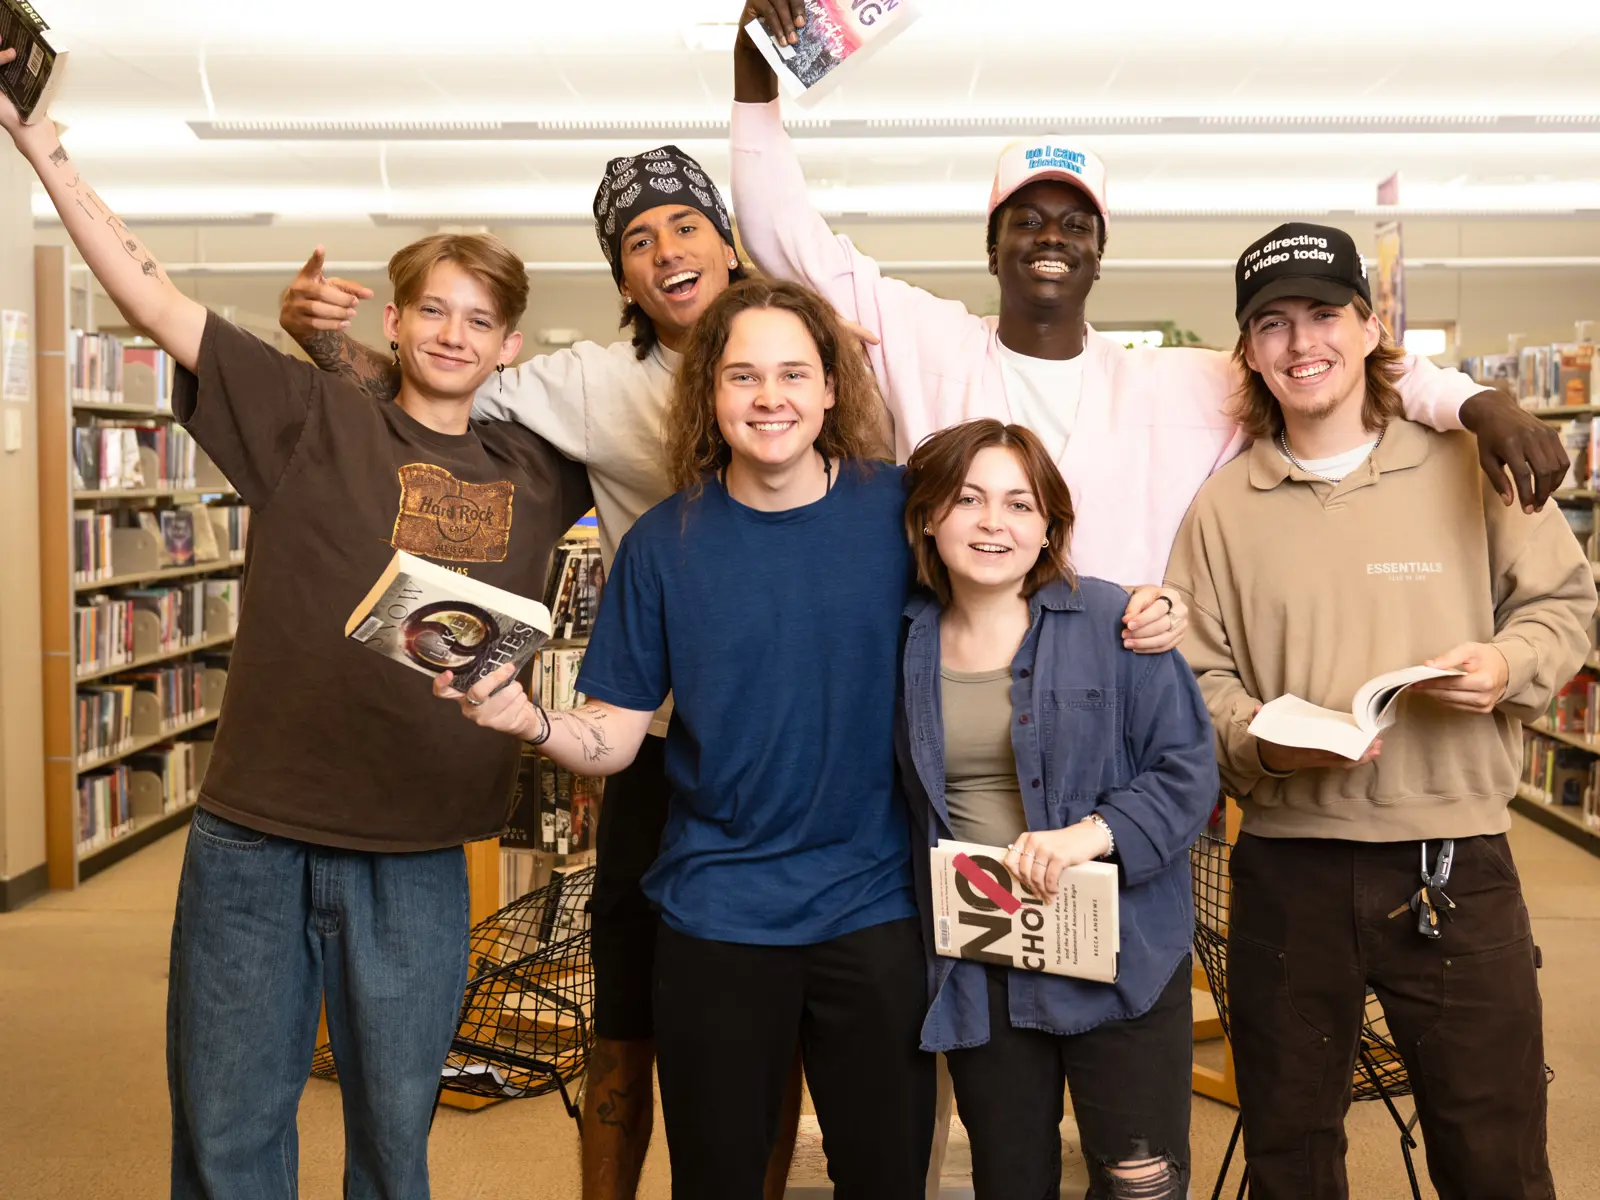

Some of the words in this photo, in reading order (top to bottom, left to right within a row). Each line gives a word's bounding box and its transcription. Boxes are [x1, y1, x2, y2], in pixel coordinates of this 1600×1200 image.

[21, 2, 42, 24] EDGE
[1025, 148, 1043, 160] no
[1046, 145, 1052, 157] I
[1053, 147, 1086, 167] can't
[1244, 249, 1261, 267] I'm
[1263, 235, 1328, 254] directing
[1244, 269, 1251, 280] a
[1252, 252, 1290, 272] video
[1293, 249, 1335, 264] today
[419, 496, 456, 520] Hard
[460, 504, 494, 526] Rock
[434, 543, 449, 554] ALL
[450, 544, 458, 554] IS
[458, 545, 475, 556] ONE
[1366, 561, 1443, 575] ESSENTIALS
[429, 618, 468, 659] LIKE
[479, 622, 535, 679] HES
[954, 854, 1014, 967] NO
[1020, 883, 1046, 972] CHOI
